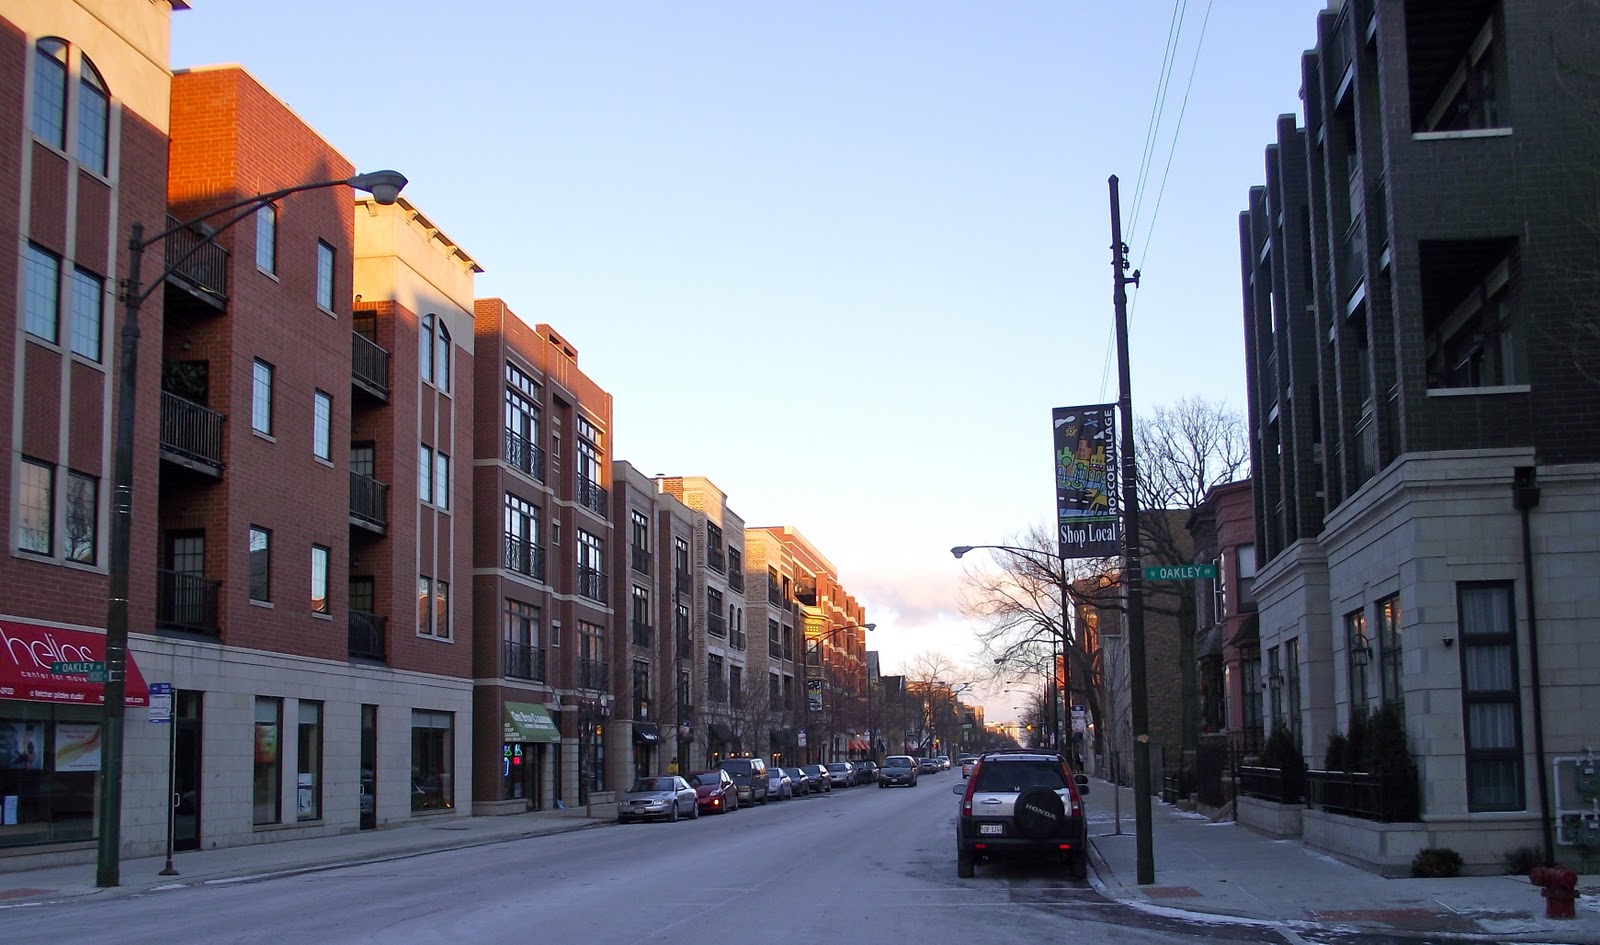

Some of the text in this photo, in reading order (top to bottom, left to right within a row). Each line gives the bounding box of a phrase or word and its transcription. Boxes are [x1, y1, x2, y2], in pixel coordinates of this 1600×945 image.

[1104, 409, 1116, 515] ROSCOE VILLAGE
[1060, 523, 1116, 547] Shop Local
[1159, 567, 1202, 579] OAKLEY
[0, 627, 95, 670] helios
[21, 671, 49, 679] center
[62, 662, 95, 673] OAKLEY
[1025, 803, 1057, 821] HONDA
